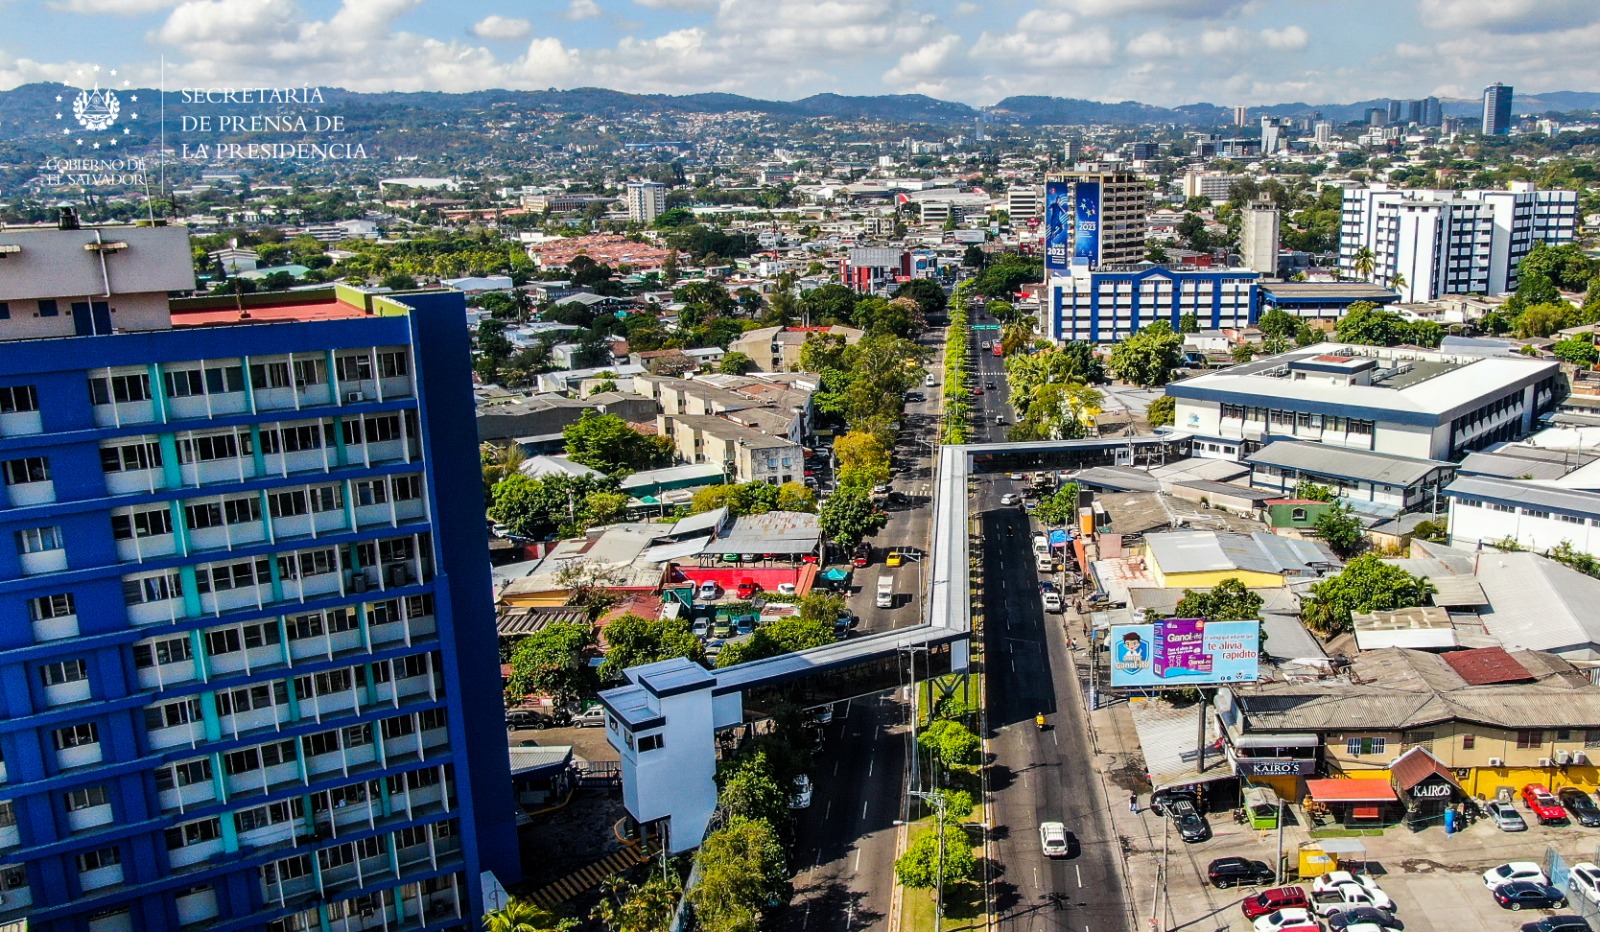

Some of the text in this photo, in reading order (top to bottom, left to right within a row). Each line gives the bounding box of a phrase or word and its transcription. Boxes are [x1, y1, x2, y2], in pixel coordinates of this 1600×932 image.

[1079, 223, 1096, 231] 2023
[1047, 247, 1065, 255] 2023
[1208, 642, 1217, 650] te
[1219, 641, 1242, 650] alivia
[1222, 650, 1256, 660] rapidito
